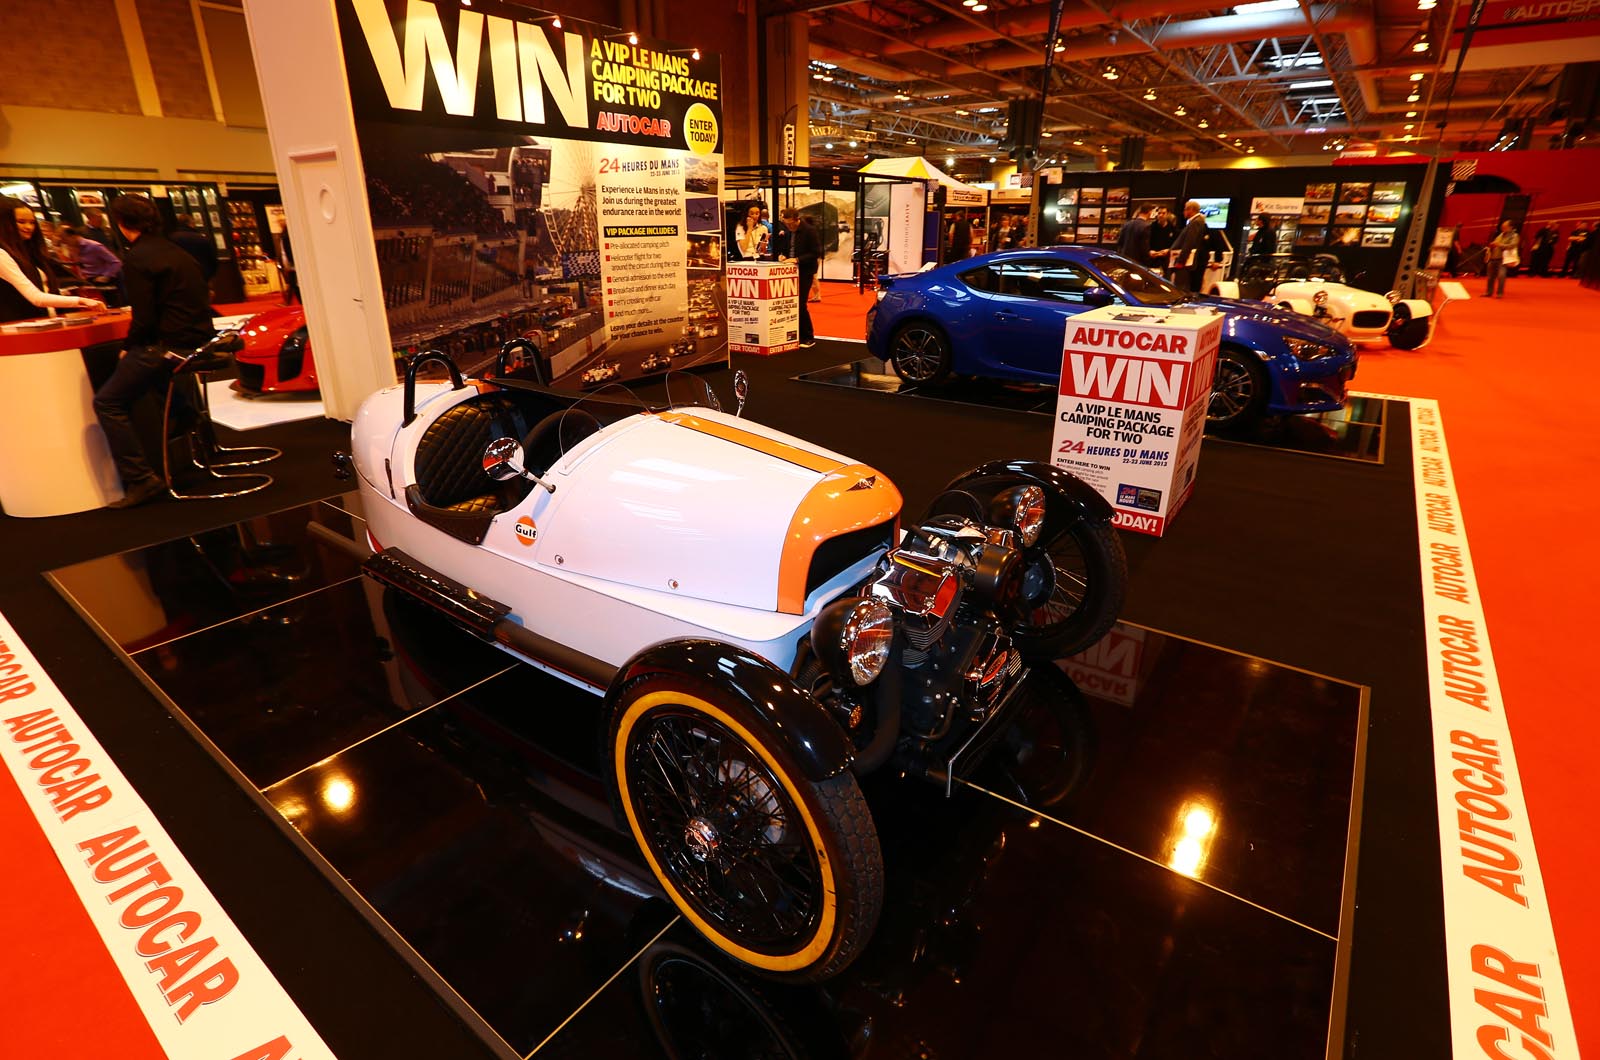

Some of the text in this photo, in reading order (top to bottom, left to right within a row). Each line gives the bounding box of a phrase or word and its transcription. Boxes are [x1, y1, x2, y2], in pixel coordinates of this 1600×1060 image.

[352, 0, 589, 129] WIN
[591, 38, 689, 76] A VIP LE MANS
[591, 59, 718, 100] CAMPING PACKAGE
[593, 81, 661, 110] FOR TWO
[596, 111, 672, 138] AUTOCAR
[690, 119, 713, 131] ENTER
[690, 131, 716, 144] TODAY!
[599, 157, 680, 174] 24 HEURES DU MANS
[601, 185, 680, 196] Experience Le Mans in style.
[602, 196, 615, 205] Join
[624, 196, 643, 207] during
[644, 197, 653, 205] the
[654, 197, 677, 207] greatest
[602, 208, 635, 216] endurance
[655, 208, 664, 216] the
[665, 208, 682, 216] world!
[606, 226, 677, 236] VIP PACKAGE INCLUDES:
[728, 267, 758, 276] UTOCAR
[769, 266, 797, 276] AUTOCAR
[728, 279, 759, 298] WIN
[769, 278, 798, 298] WIN
[1071, 327, 1188, 354] AUTOCAR
[1070, 353, 1185, 407] WIN
[1075, 402, 1161, 424] A VIP LE MANS
[1060, 411, 1175, 438] CAMPING PACKAGE
[1086, 426, 1143, 445] FOR TWO
[1057, 439, 1169, 461] 24 HEURES DU MANS
[1421, 456, 1449, 488] AUTOCAR
[1111, 512, 1158, 532] ODAY!
[1425, 493, 1457, 536] AUTOCAR
[515, 524, 537, 538] Gulf
[1430, 542, 1470, 605] AUTOCAR
[1438, 614, 1493, 714] AUTOCAR
[2, 707, 114, 824] AUTOCAR
[1450, 729, 1530, 910] AUTOCAR
[76, 824, 241, 1026] AUTOCAR
